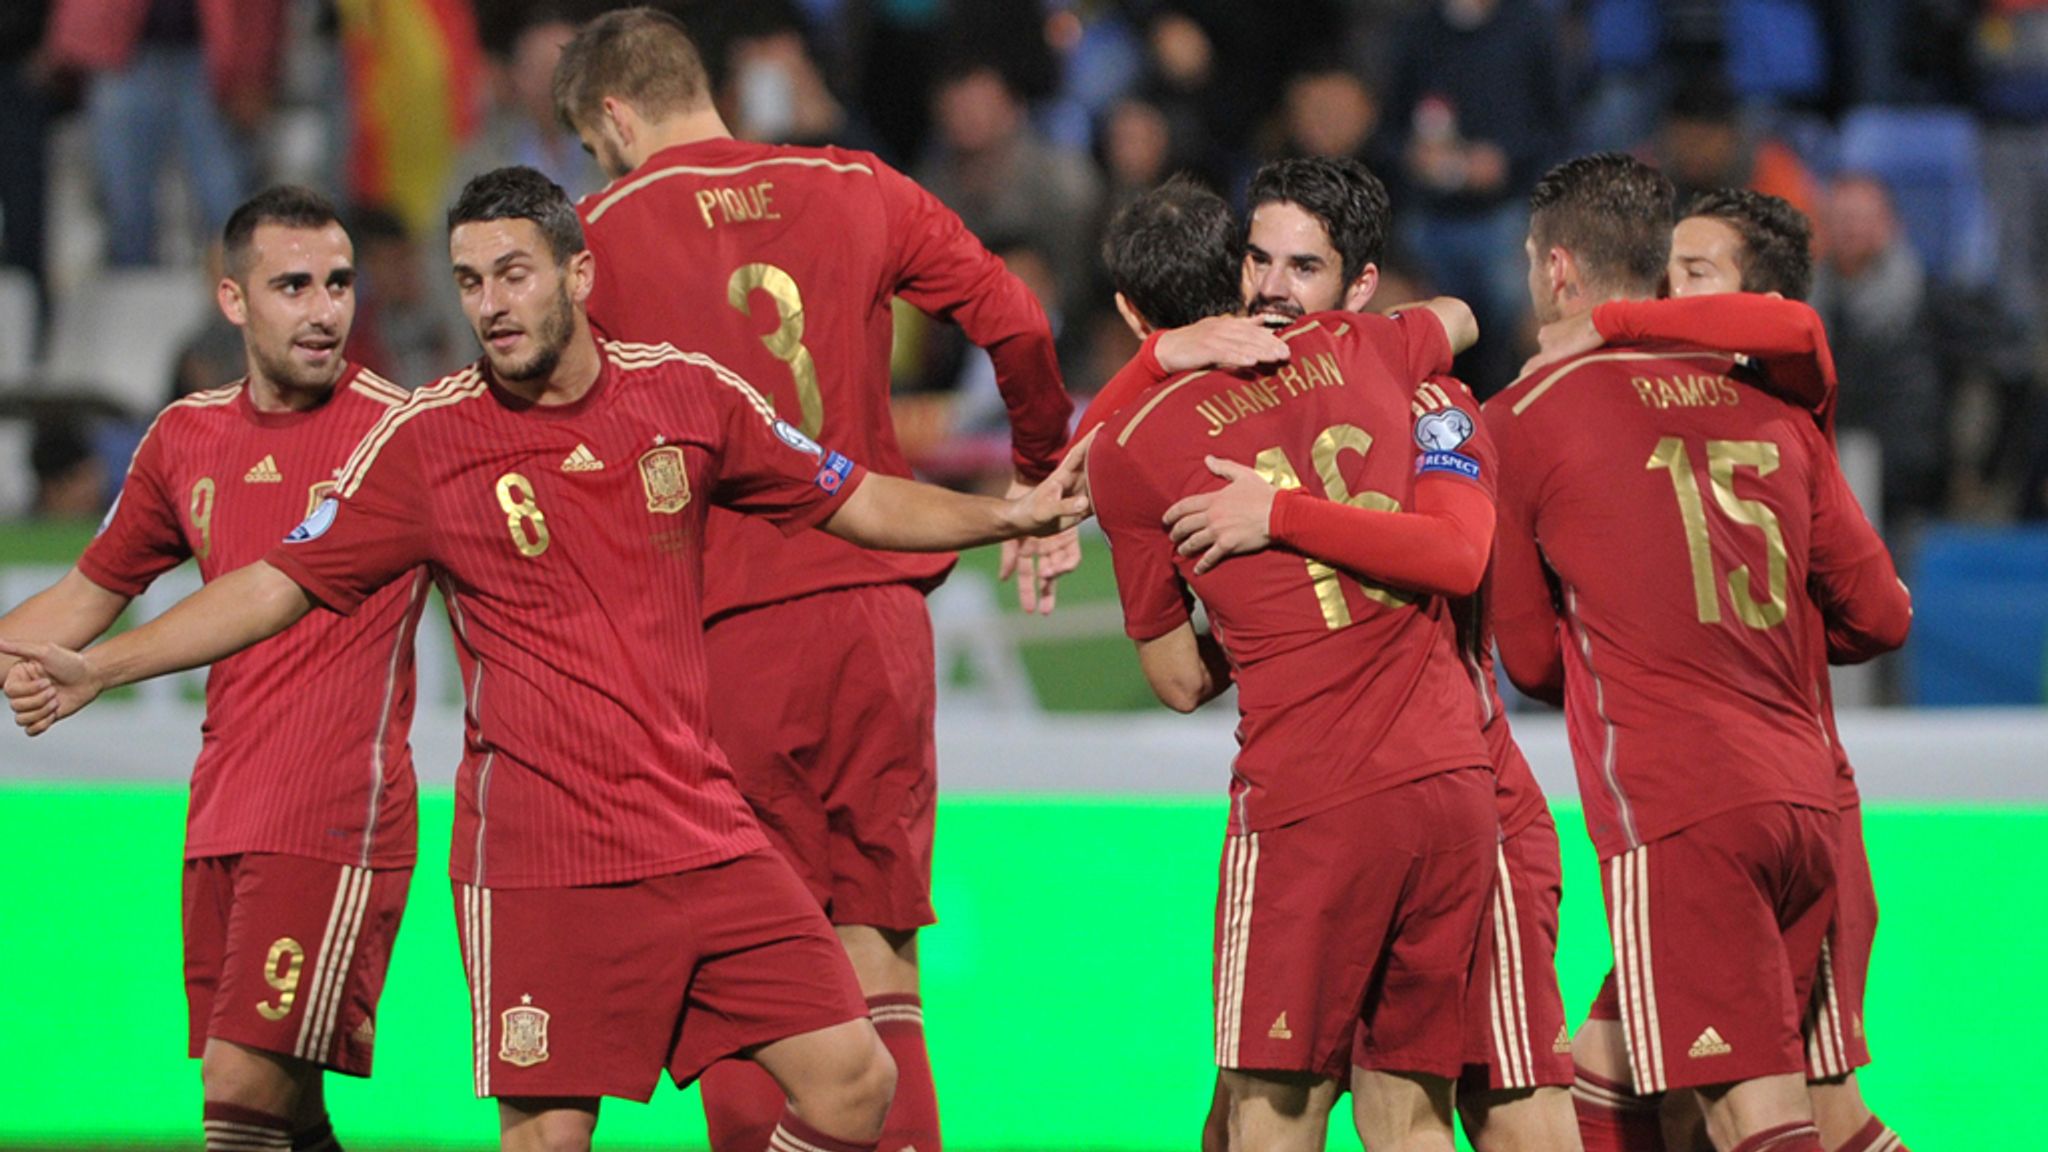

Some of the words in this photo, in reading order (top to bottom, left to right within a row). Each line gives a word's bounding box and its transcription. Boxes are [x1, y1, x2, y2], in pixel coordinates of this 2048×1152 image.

[727, 262, 824, 440] 3
[1631, 374, 1740, 410] RAMOS
[1196, 352, 1345, 437] JUANFRAN
[1426, 454, 1479, 475] RESPECT
[190, 477, 216, 560] 9
[495, 472, 550, 557] 8
[1645, 436, 1788, 629] 15
[256, 937, 304, 1021] 9
